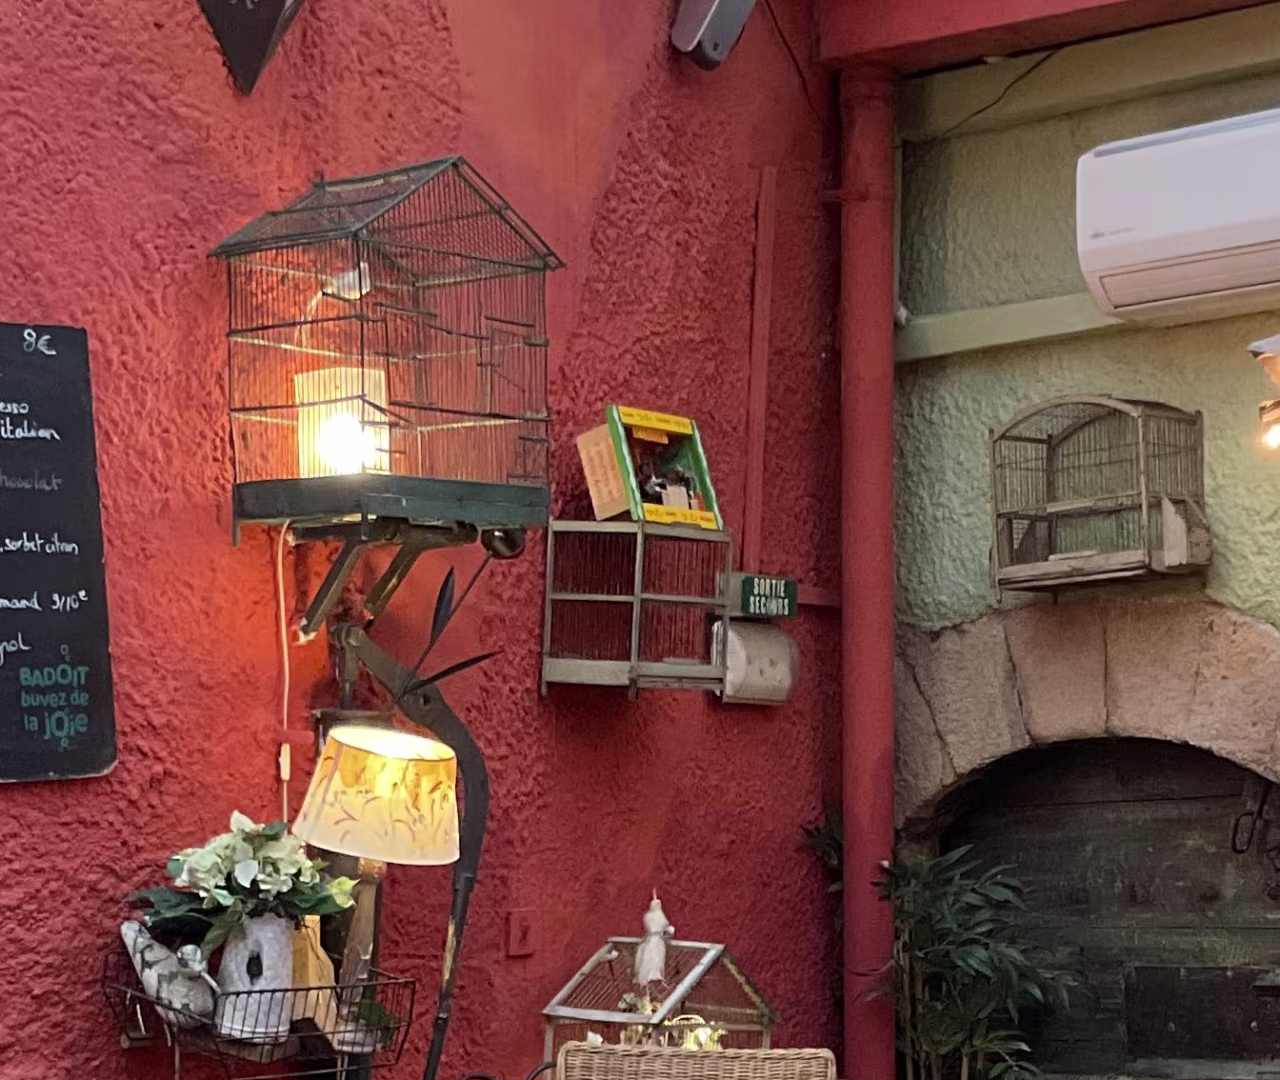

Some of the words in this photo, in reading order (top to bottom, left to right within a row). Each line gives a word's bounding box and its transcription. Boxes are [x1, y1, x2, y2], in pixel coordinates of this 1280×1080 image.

[753, 577, 786, 597] SORTIE
[19, 664, 89, 687] BADOIT
[21, 689, 66, 707] buvez
[71, 689, 89, 706] de
[24, 714, 38, 731] la
